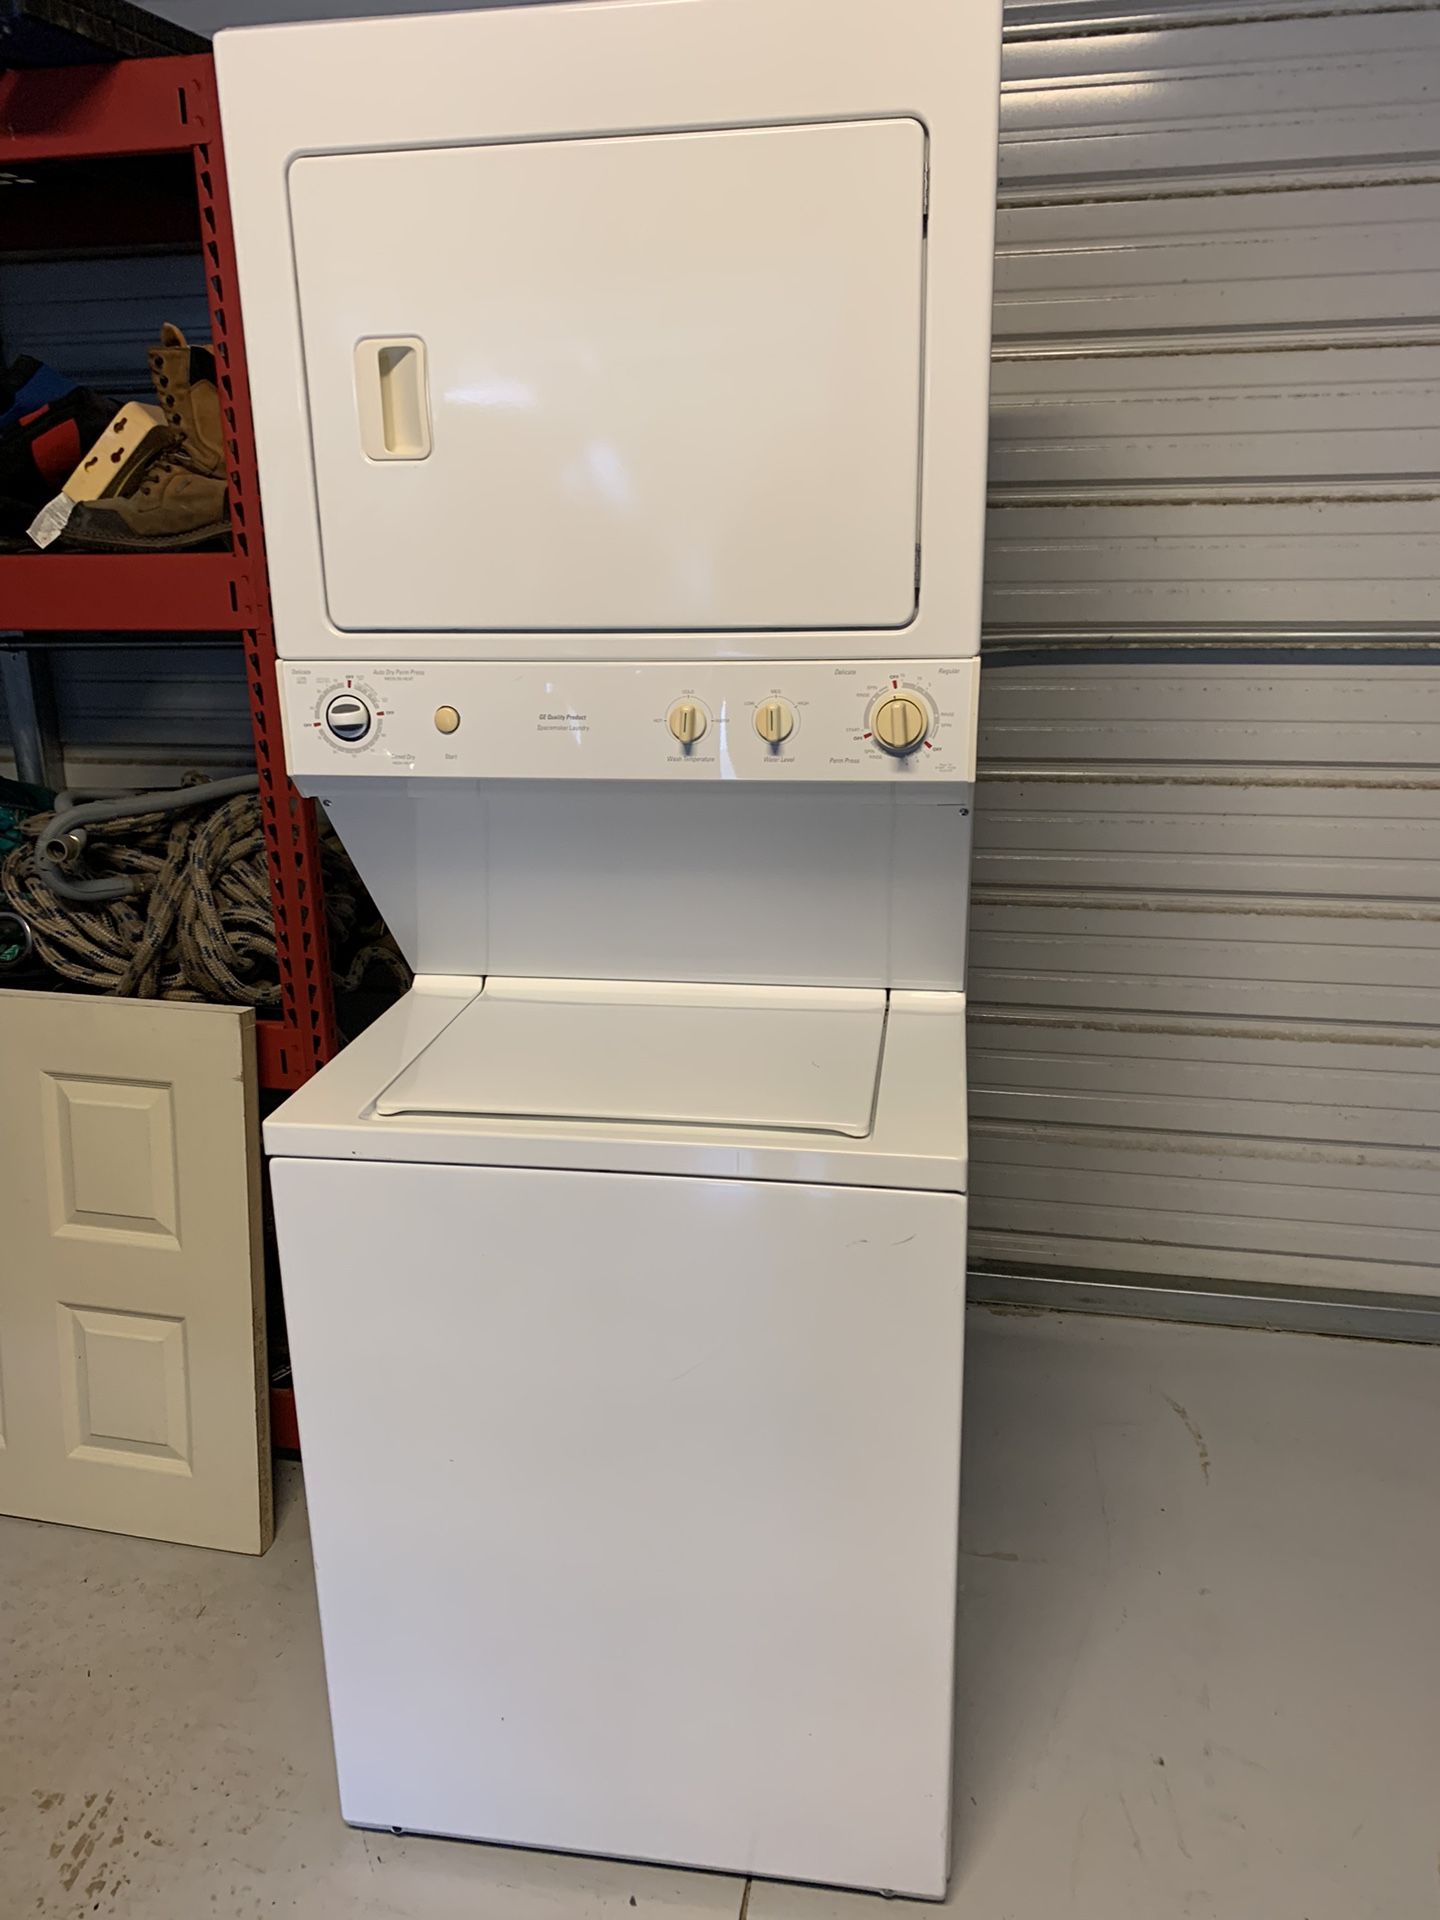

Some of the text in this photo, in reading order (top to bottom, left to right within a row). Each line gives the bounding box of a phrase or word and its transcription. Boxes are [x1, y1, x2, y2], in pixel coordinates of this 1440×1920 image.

[938, 667, 960, 675] Regular
[547, 713, 565, 721] Quality
[566, 713, 587, 721] Product
[568, 724, 590, 732] Laundry
